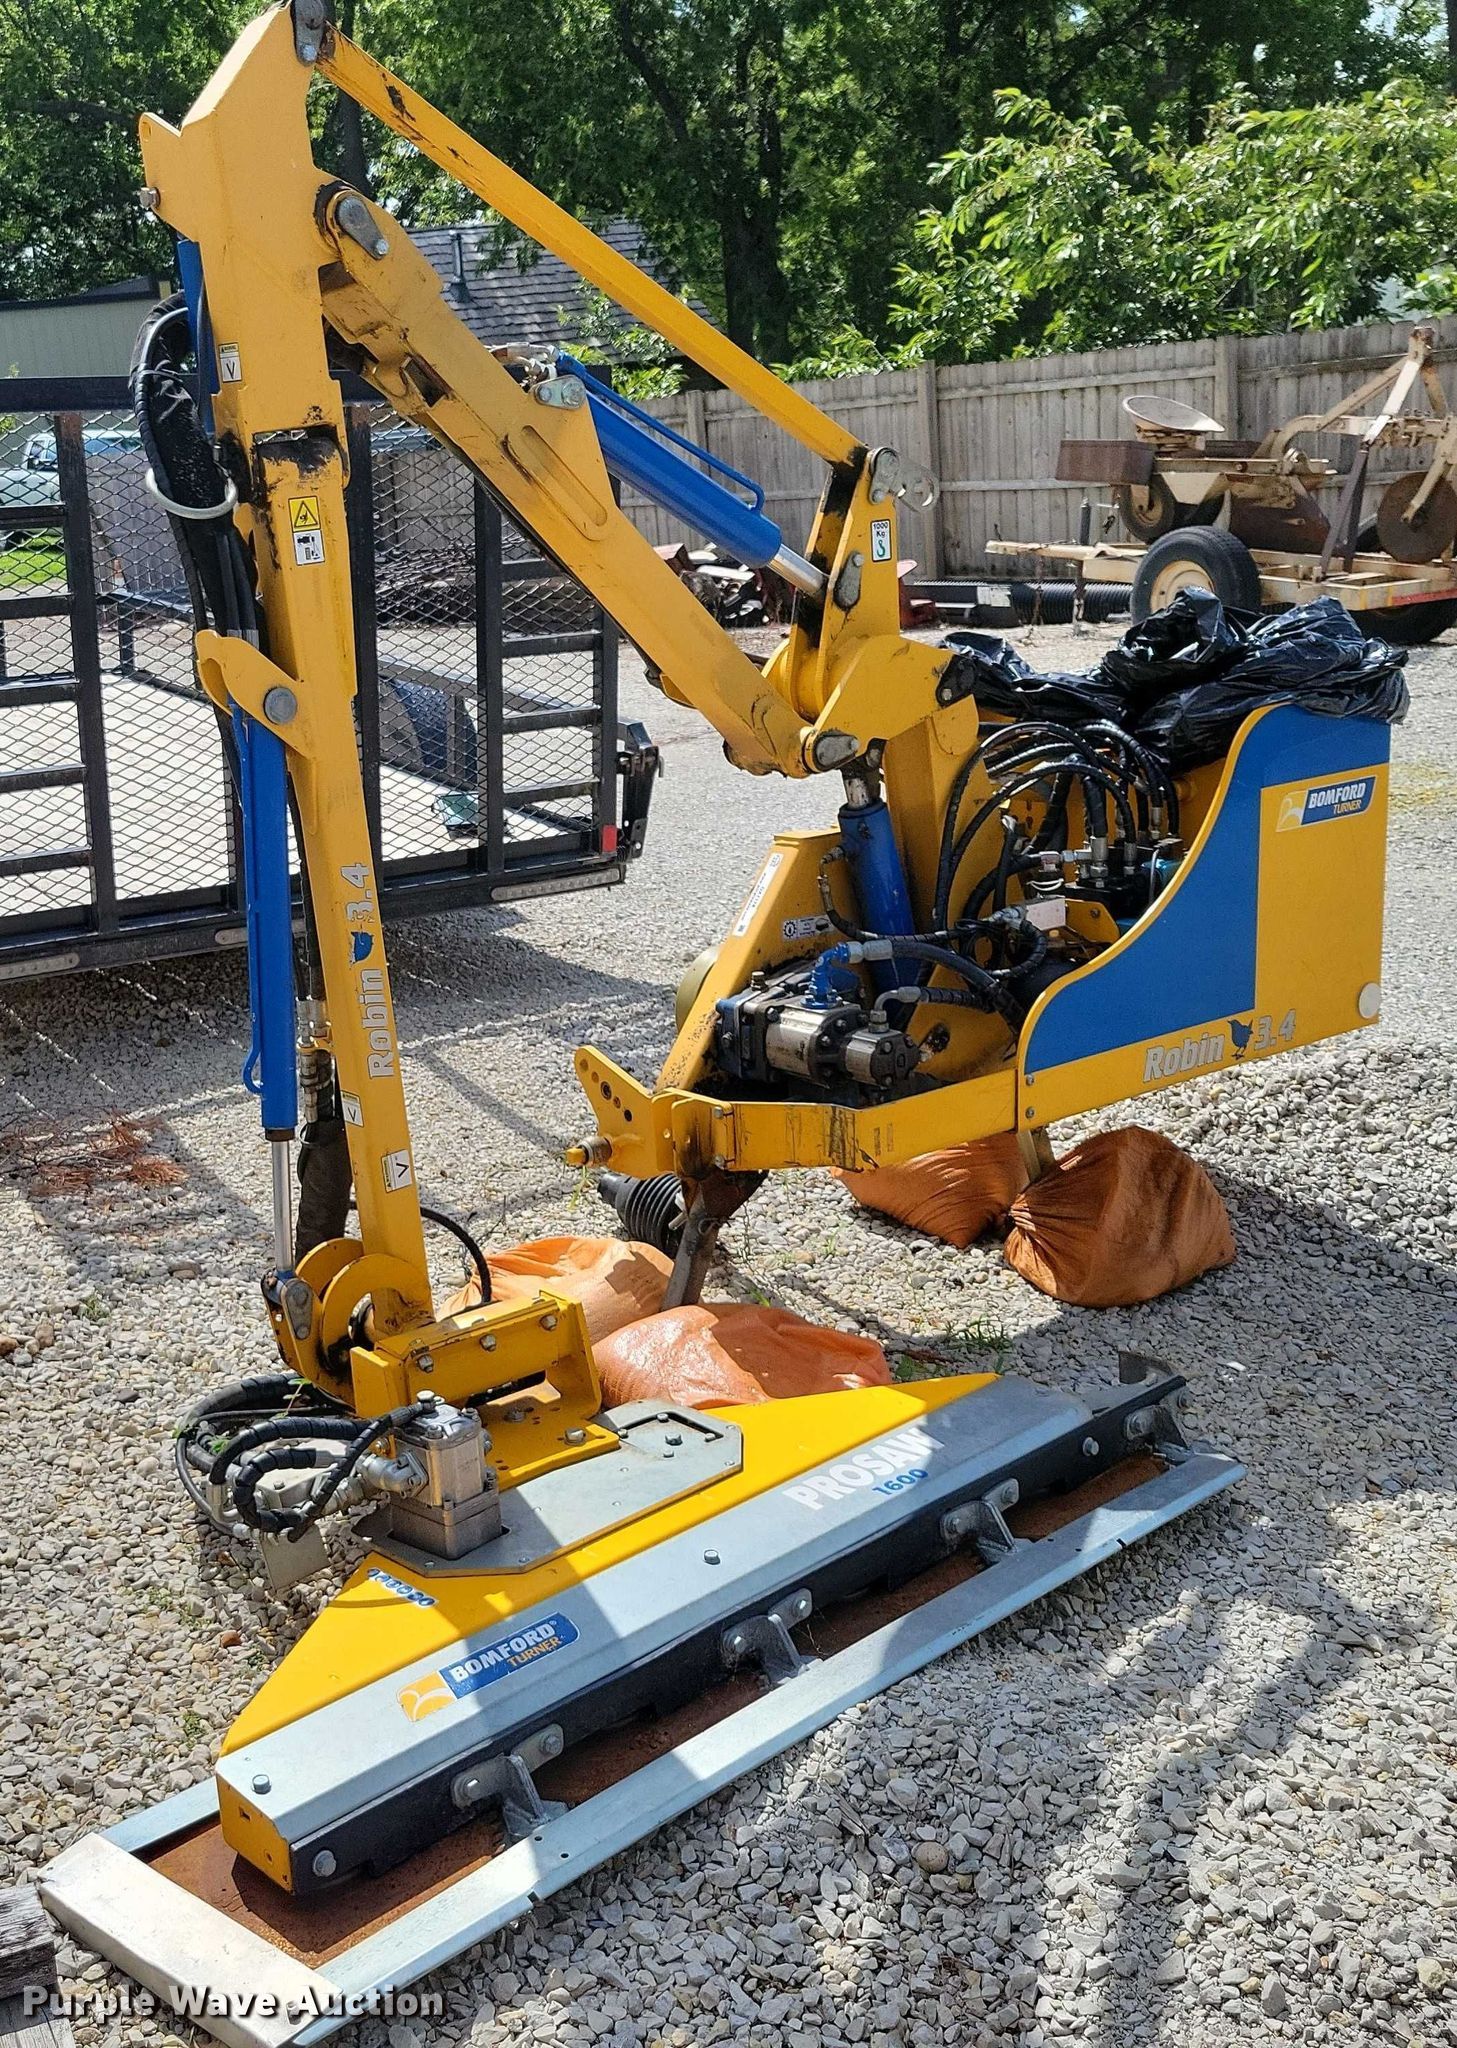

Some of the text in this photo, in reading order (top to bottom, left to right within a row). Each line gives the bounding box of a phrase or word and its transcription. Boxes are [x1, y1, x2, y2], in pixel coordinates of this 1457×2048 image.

[873, 521, 888, 530] 1000
[1308, 782, 1366, 808] BOMFORD
[1333, 799, 1362, 815] TURNER
[340, 862, 395, 1079] Robin 3.4
[1143, 1008, 1297, 1083] Robin 3.4
[782, 1426, 945, 1511] PROSAW
[872, 1467, 929, 1496] 1600
[506, 1636, 563, 1667] TURNER
